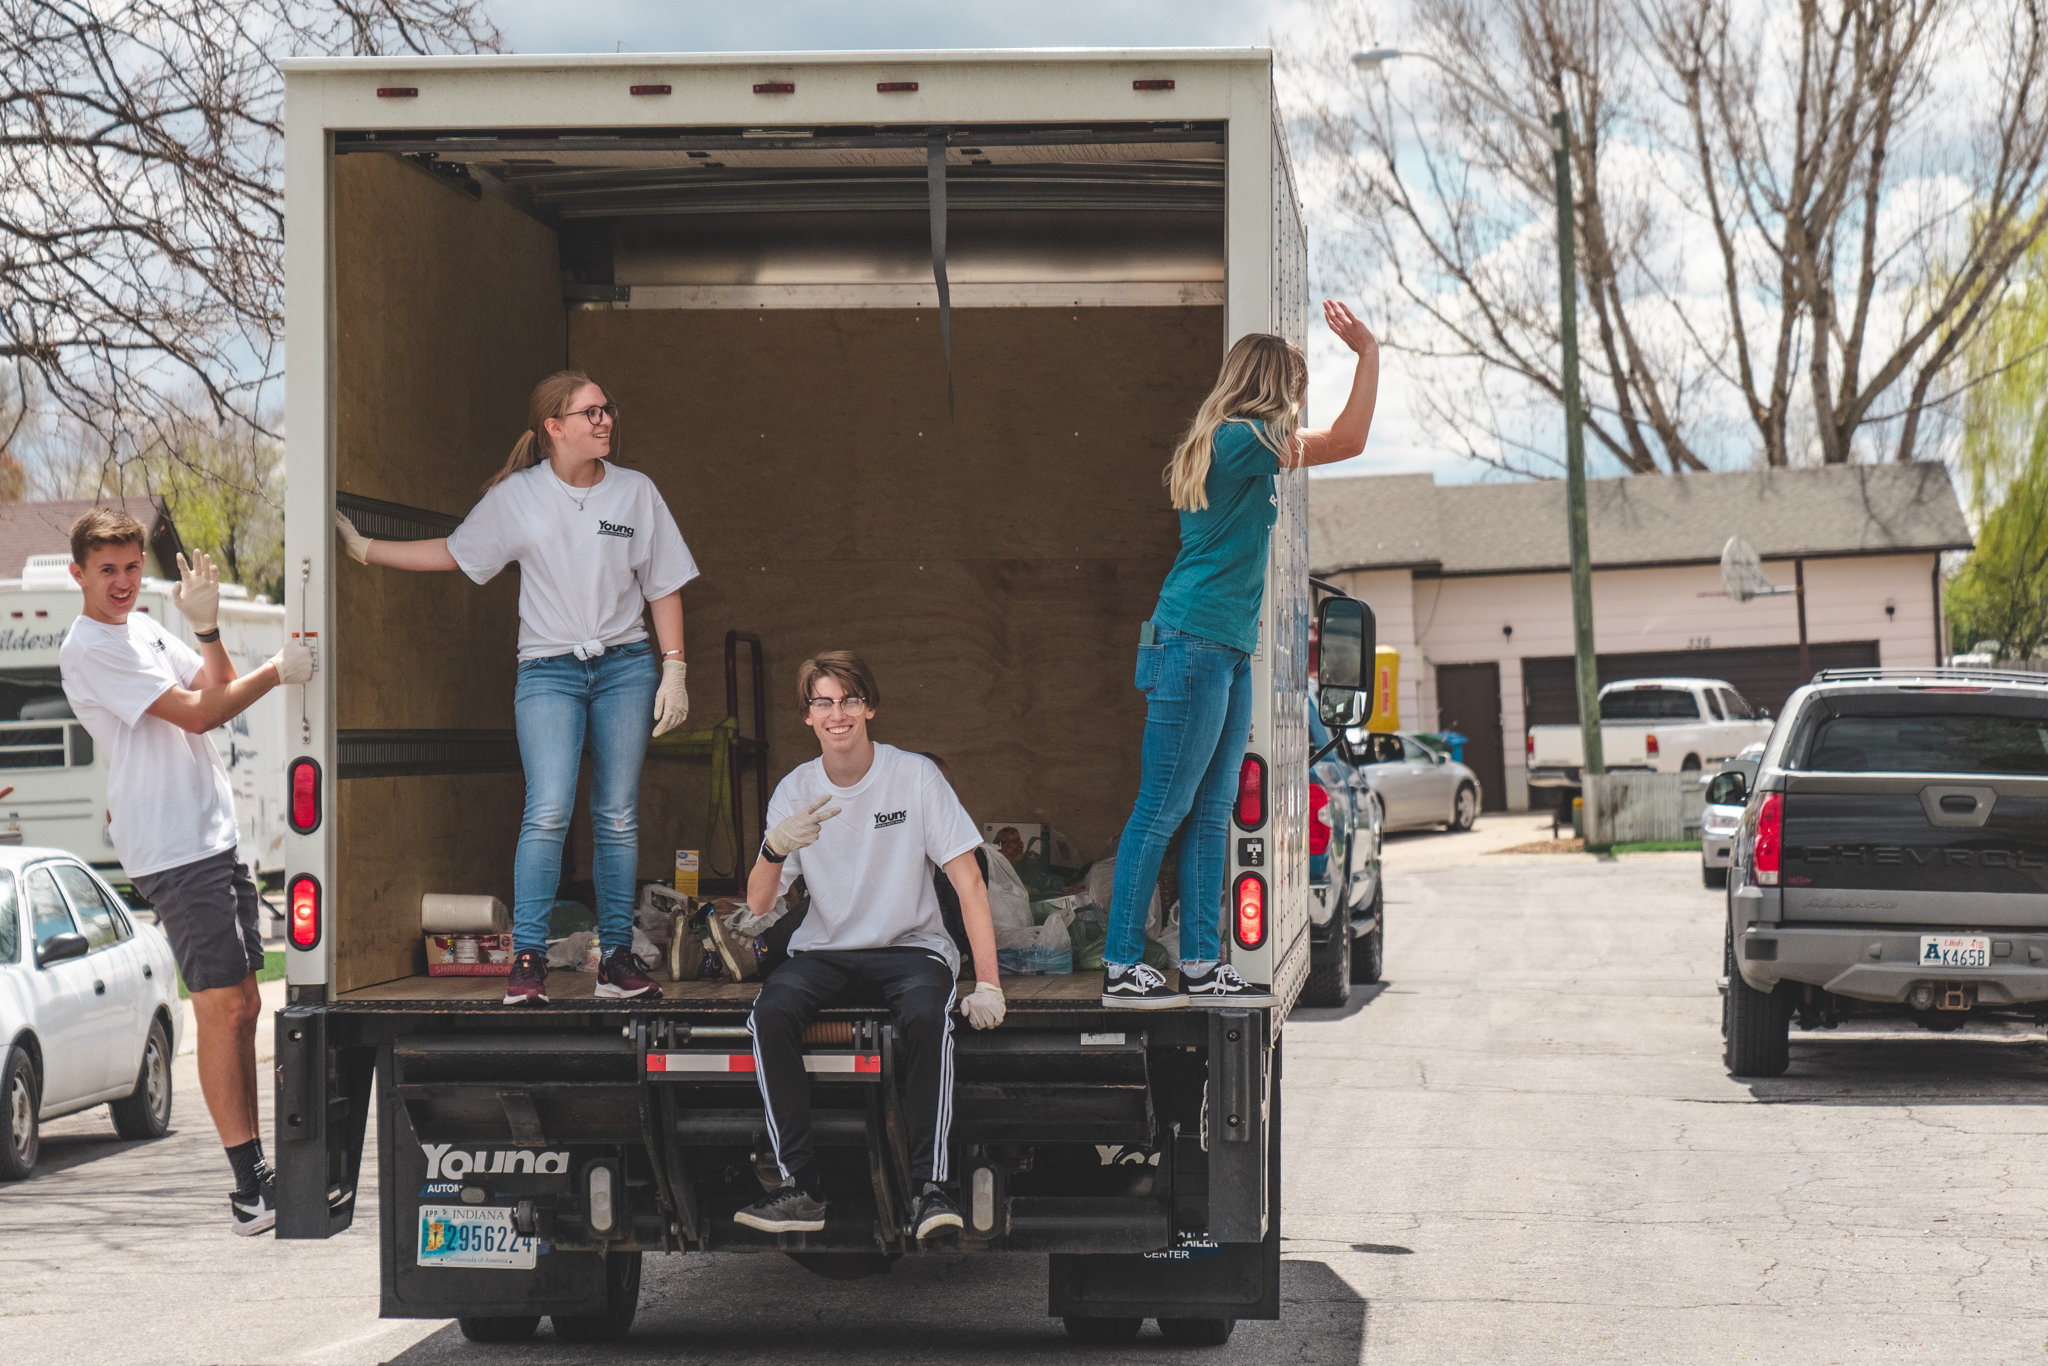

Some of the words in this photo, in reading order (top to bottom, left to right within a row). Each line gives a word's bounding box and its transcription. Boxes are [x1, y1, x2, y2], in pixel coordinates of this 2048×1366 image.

[598, 520, 635, 537] Young
[1943, 949, 1985, 966] K465B
[435, 965, 472, 974] SHRIMP
[474, 965, 511, 973] FLAVOR
[452, 1209, 505, 1220] INDIANA
[446, 1224, 532, 1253] 2956224
